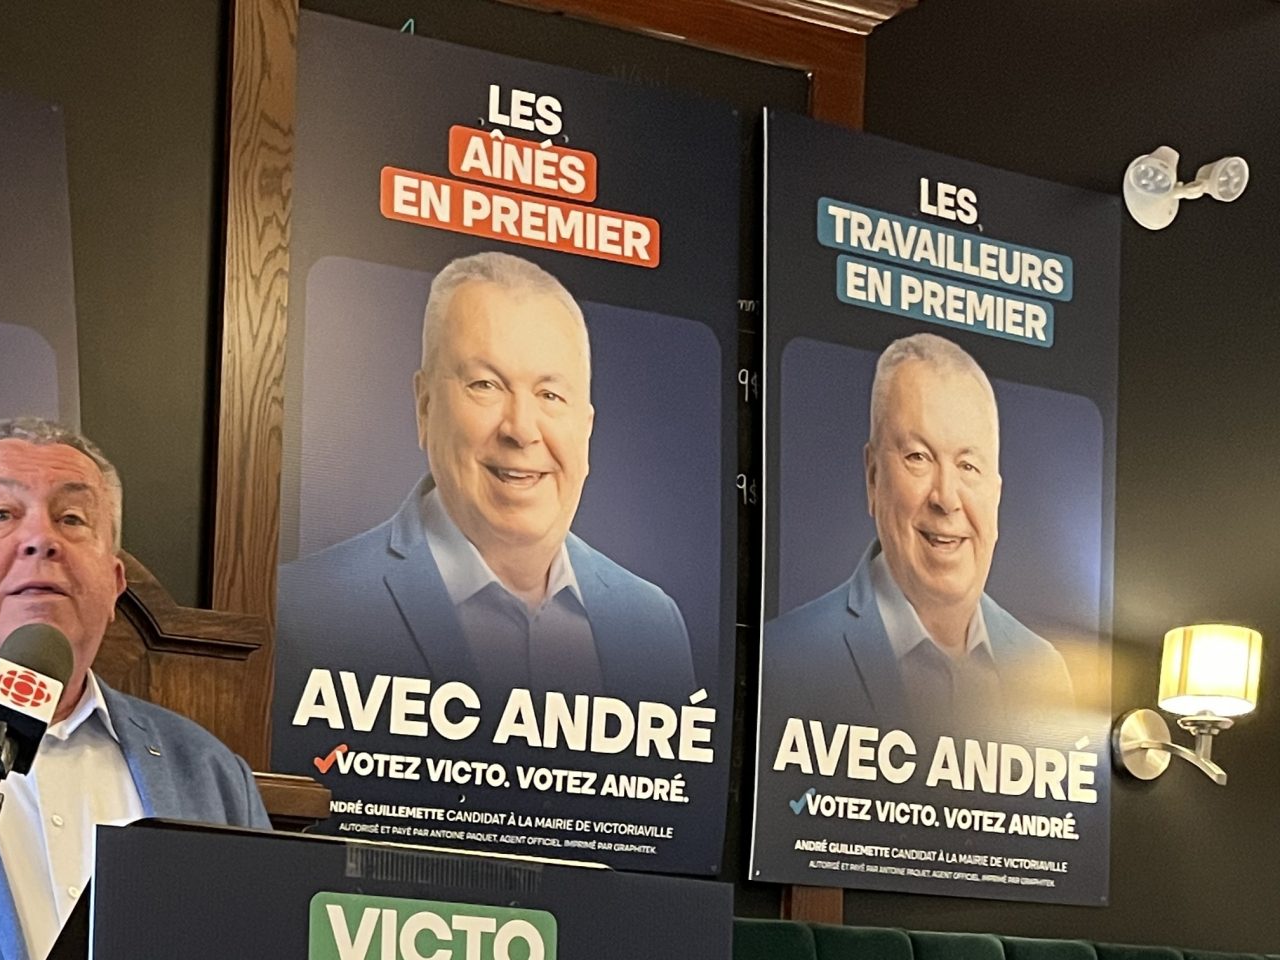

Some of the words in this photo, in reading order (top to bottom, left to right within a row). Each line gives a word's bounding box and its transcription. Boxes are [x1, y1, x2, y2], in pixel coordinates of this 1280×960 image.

[489, 84, 562, 135] LES
[460, 129, 586, 194] AÎNÉS
[393, 175, 451, 223] EN
[463, 189, 651, 261] PREMIER
[920, 177, 978, 225] LES
[827, 205, 1065, 295] TRAVAILLEURS
[846, 261, 892, 306] EN
[900, 274, 1048, 342] PREMIER
[292, 668, 482, 741] AVEC
[492, 688, 716, 763] ANDRÉ
[334, 750, 421, 781] VOTEZ
[426, 757, 511, 789] VICTO.
[516, 765, 597, 796] VOTEZ
[600, 773, 690, 804] ANDRÉ.
[772, 717, 917, 784] AVEC
[926, 735, 1098, 803] ANDRÉ
[329, 800, 363, 815] NDRÉ
[364, 804, 445, 821] GUILLEMETTE
[446, 810, 507, 826] CANDIDAT
[507, 811, 516, 826] À
[518, 816, 533, 827] LA
[534, 817, 574, 831] MAIRIE
[575, 820, 591, 832] DE
[593, 822, 674, 839] VICTORIAVILLE
[381, 826, 391, 835] ET
[413, 828, 429, 837] PAR
[430, 829, 464, 840] ANTOINE
[806, 793, 871, 821] VOTEZ
[875, 800, 940, 827] VICTO.
[943, 806, 1006, 834] VOTEZ
[1008, 812, 1080, 840] ANDRÉ.
[794, 839, 828, 852] ANDRÉ
[828, 842, 890, 858] GUILLEMETTE
[891, 847, 937, 861] CANDIDAT
[946, 853, 958, 863] LA
[990, 856, 1002, 868] DE
[1003, 858, 1068, 873] VICTORIAVILLE
